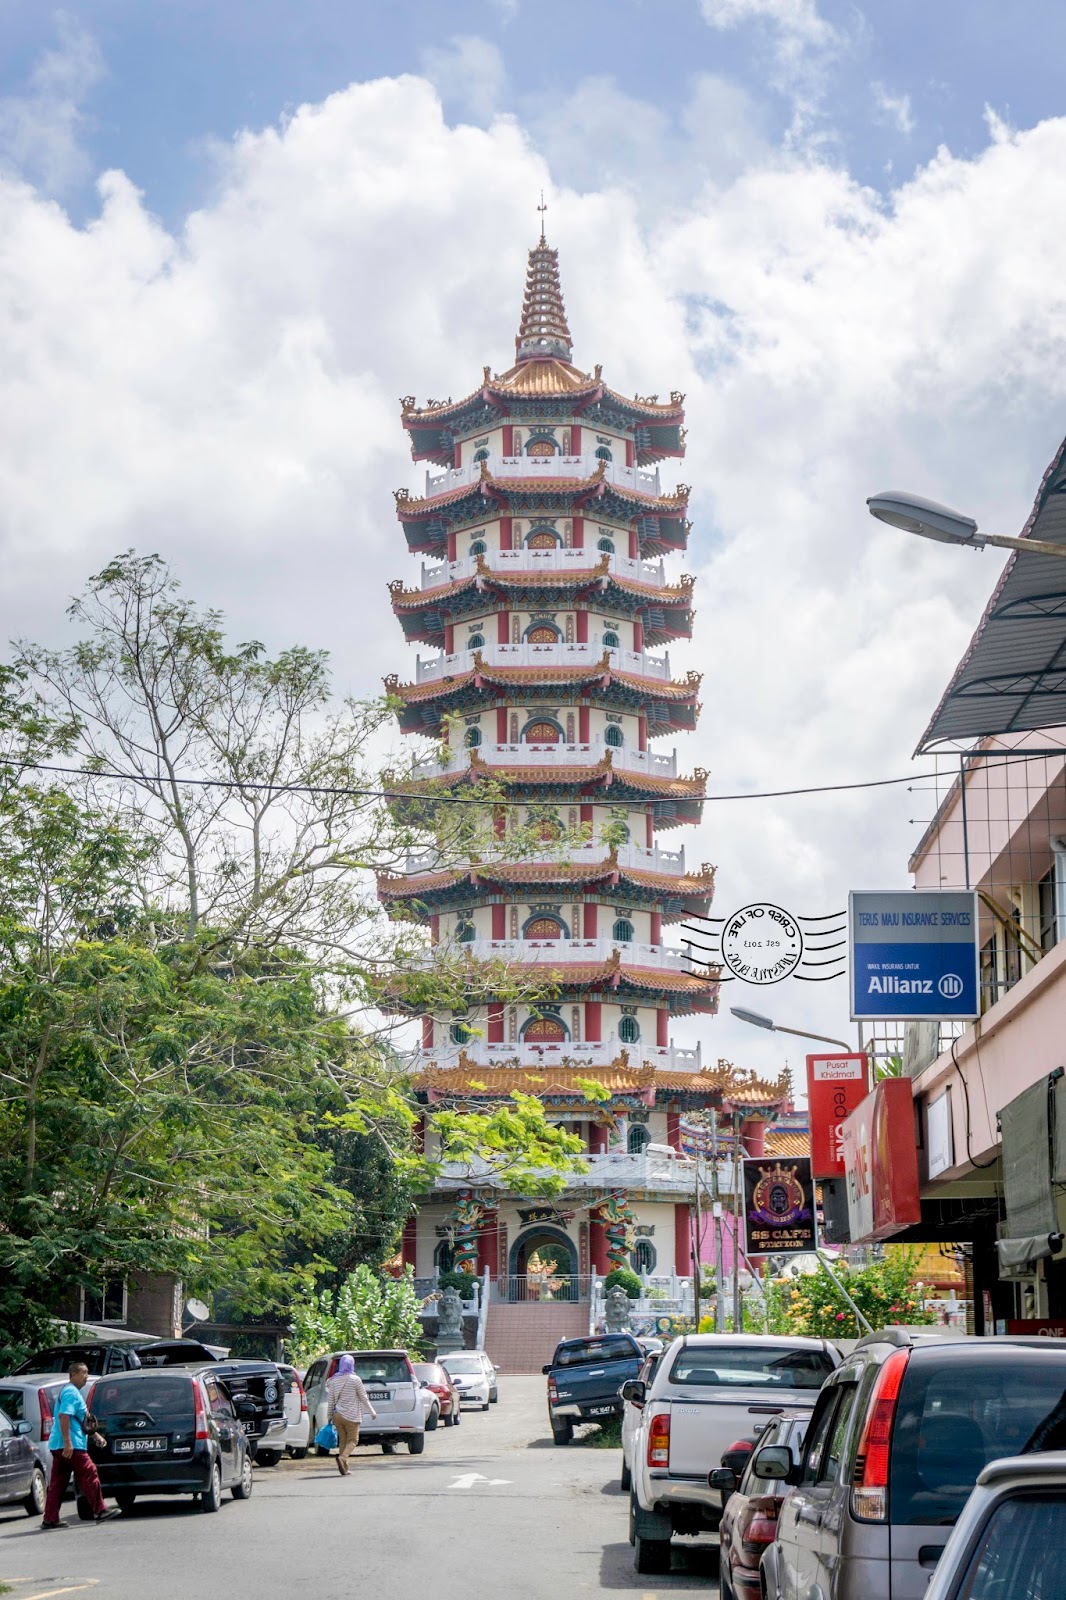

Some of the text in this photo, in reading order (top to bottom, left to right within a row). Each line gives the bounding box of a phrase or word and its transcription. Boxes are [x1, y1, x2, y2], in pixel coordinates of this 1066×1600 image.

[858, 912, 971, 926] TERUS MAJU INSURANCE SERVICES
[867, 976, 934, 994] Allianz
[826, 1061, 849, 1069] Pusat
[820, 1071, 855, 1079] Khidmat
[751, 1229, 811, 1240] SS CAFE
[121, 1440, 161, 1450] SAB 5754 K
